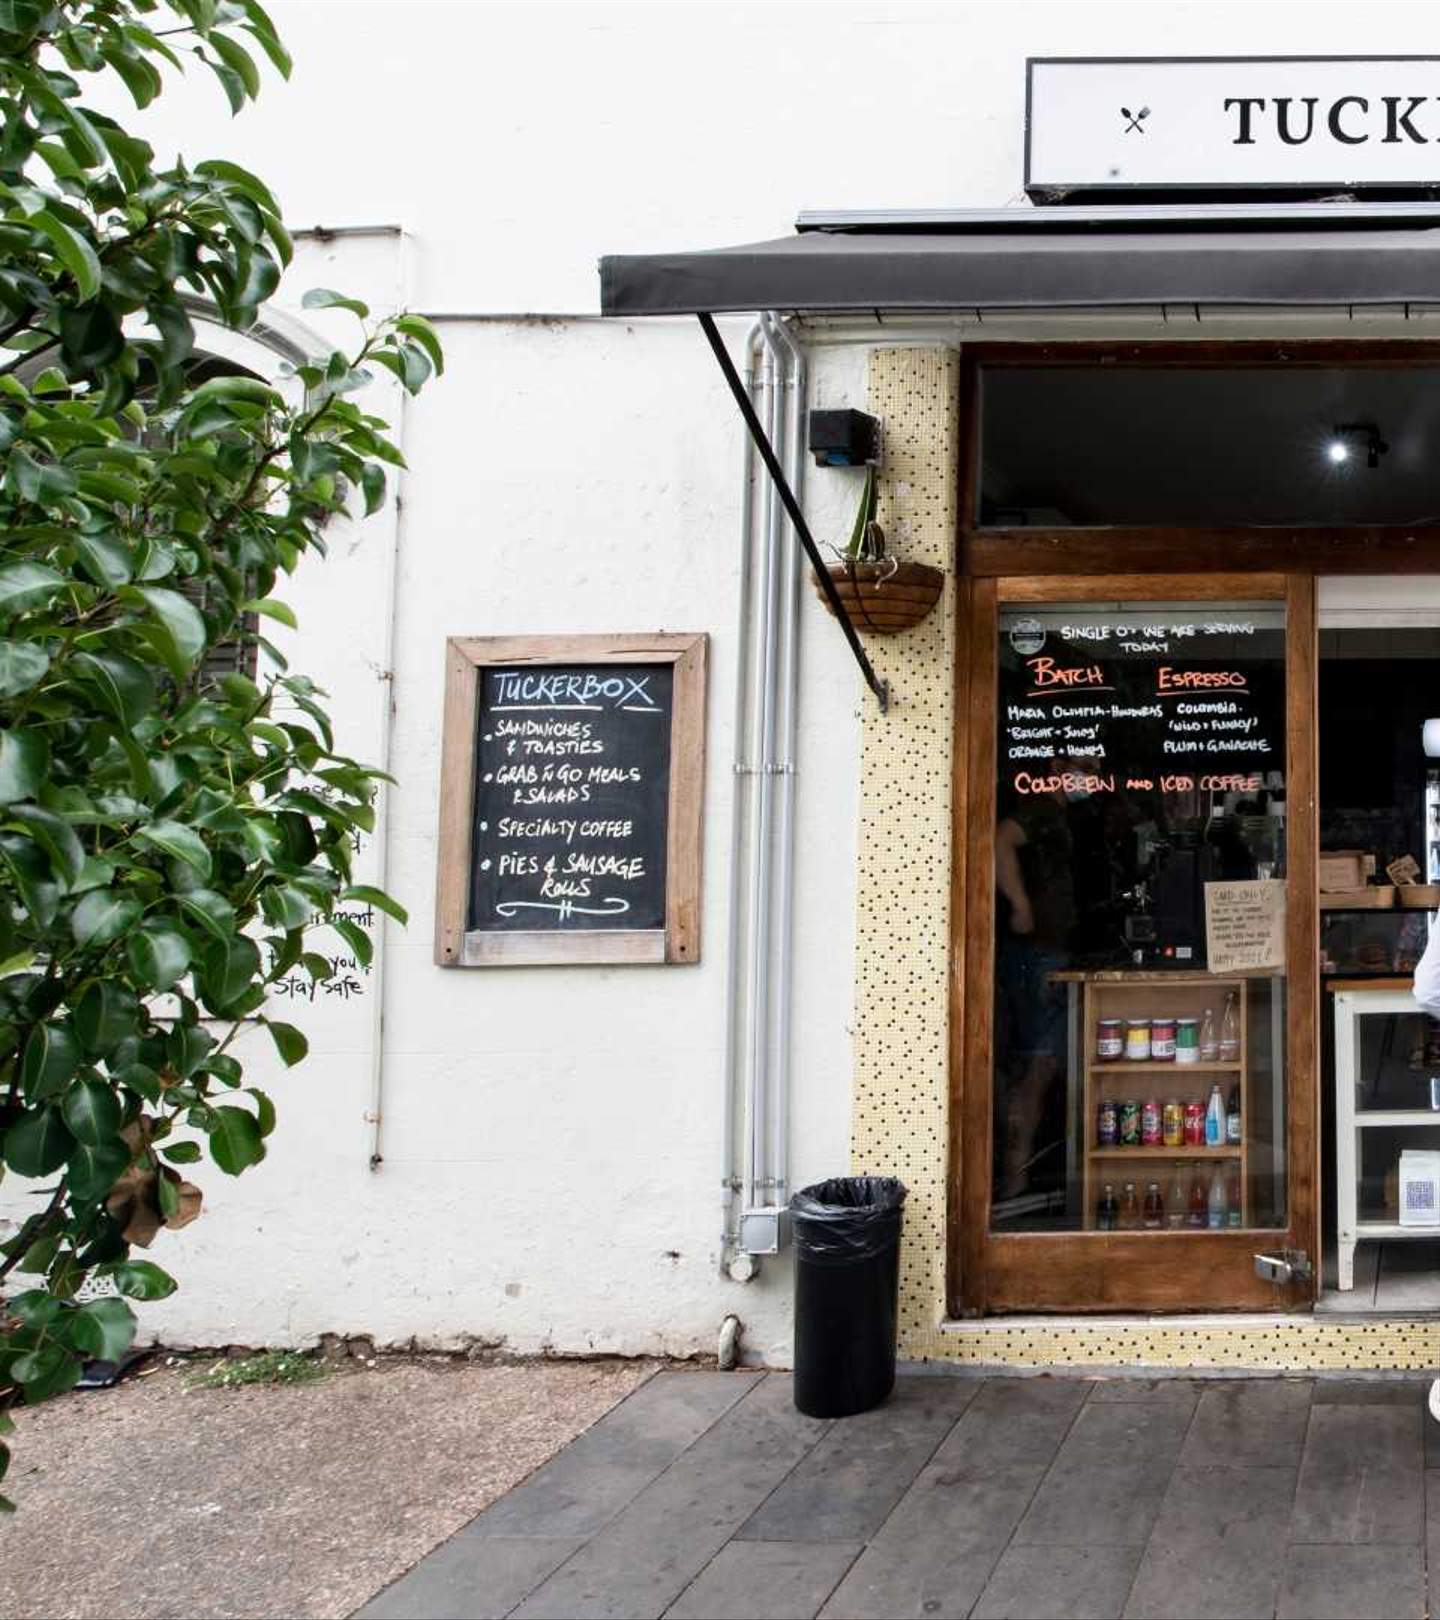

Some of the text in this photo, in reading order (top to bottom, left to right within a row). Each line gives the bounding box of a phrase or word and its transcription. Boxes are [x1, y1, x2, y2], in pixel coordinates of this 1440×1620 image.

[1060, 625, 1111, 641] SINGLE
[1144, 624, 1165, 638] WE
[1171, 624, 1195, 638] ARE
[1119, 642, 1169, 653] TODAY
[1026, 657, 1104, 686] BATCH
[1158, 666, 1246, 688] ESPRESSO
[494, 672, 655, 707] TUCKERBOX
[495, 718, 591, 738] SANDWICHES
[524, 740, 604, 755] TOASTIES
[1008, 745, 1055, 759] ORANGE
[1067, 744, 1106, 757] HONEY
[1163, 740, 1197, 753] PLUM
[1207, 739, 1272, 752] GANACHE
[496, 764, 538, 785] GRAB
[556, 764, 582, 785] GO
[1126, 779, 1153, 791] AND
[1160, 774, 1194, 791] ICED
[1200, 773, 1261, 793] COFFEE
[523, 784, 590, 804] SALADS
[498, 817, 633, 845] SPECIALTY COFFEE
[499, 851, 538, 876] PIES
[562, 852, 645, 879] SAUSAGE
[540, 878, 592, 897] ROLLS
[330, 957, 356, 976] you
[274, 975, 363, 1001] Stay safe
